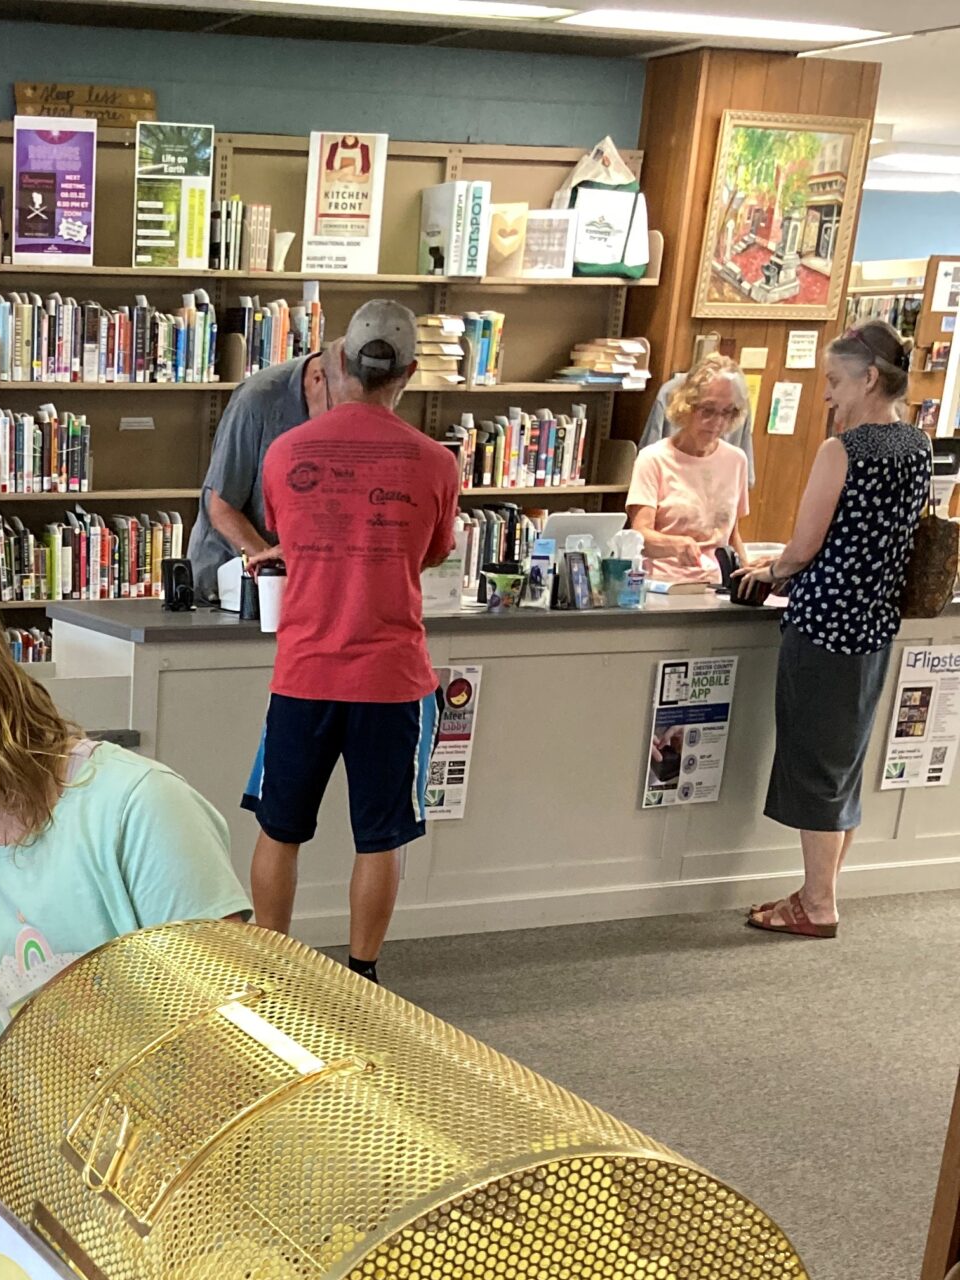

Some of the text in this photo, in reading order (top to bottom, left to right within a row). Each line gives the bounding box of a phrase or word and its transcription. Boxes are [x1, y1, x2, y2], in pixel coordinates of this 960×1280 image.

[161, 154, 188, 164] Life on
[163, 163, 185, 174] Earth
[324, 191, 369, 200] KITCHEN
[328, 202, 363, 211] FRONT
[467, 193, 483, 268] HOTSPOT
[913, 651, 960, 673] Flipste
[691, 675, 730, 688] MOBILE
[689, 688, 711, 700] APP
[443, 711, 467, 721] Meet
[442, 721, 468, 732] Libby
